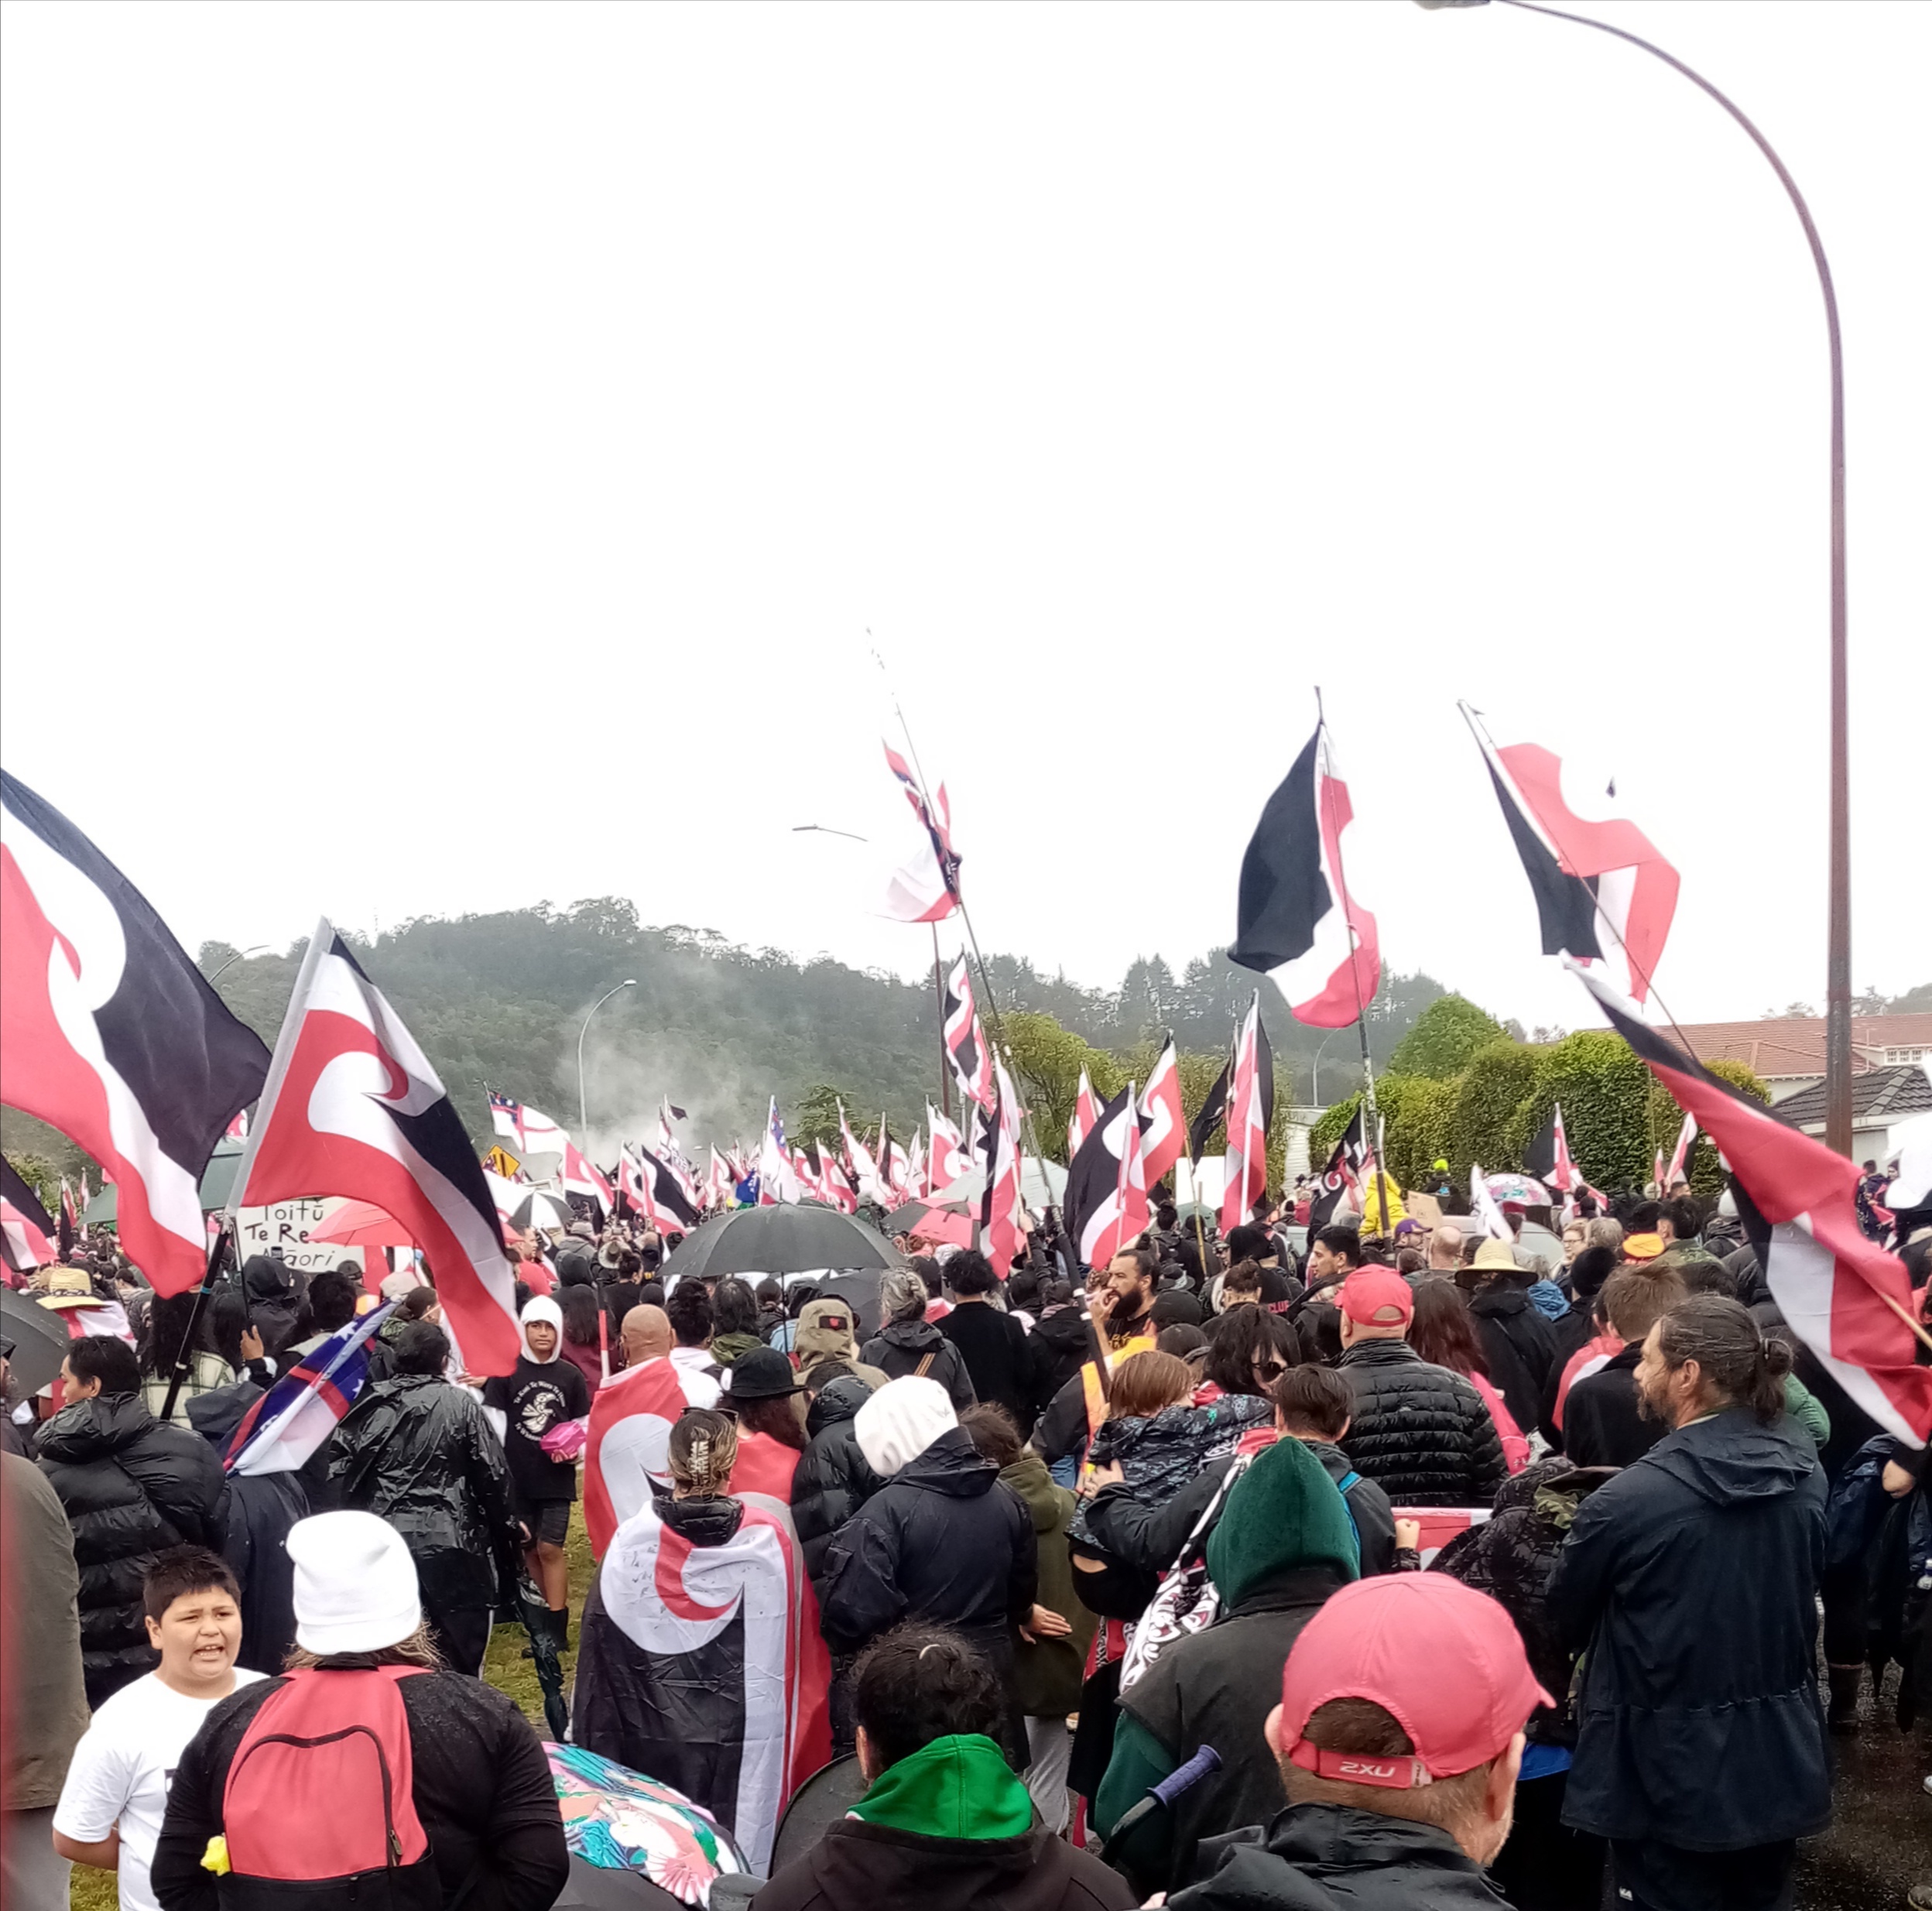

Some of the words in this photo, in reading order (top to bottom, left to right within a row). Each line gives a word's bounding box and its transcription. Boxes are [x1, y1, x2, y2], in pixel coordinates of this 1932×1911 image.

[244, 1222, 269, 1241] Te
[279, 1223, 320, 1244] Re
[1339, 1761, 1396, 1779] 2XU
